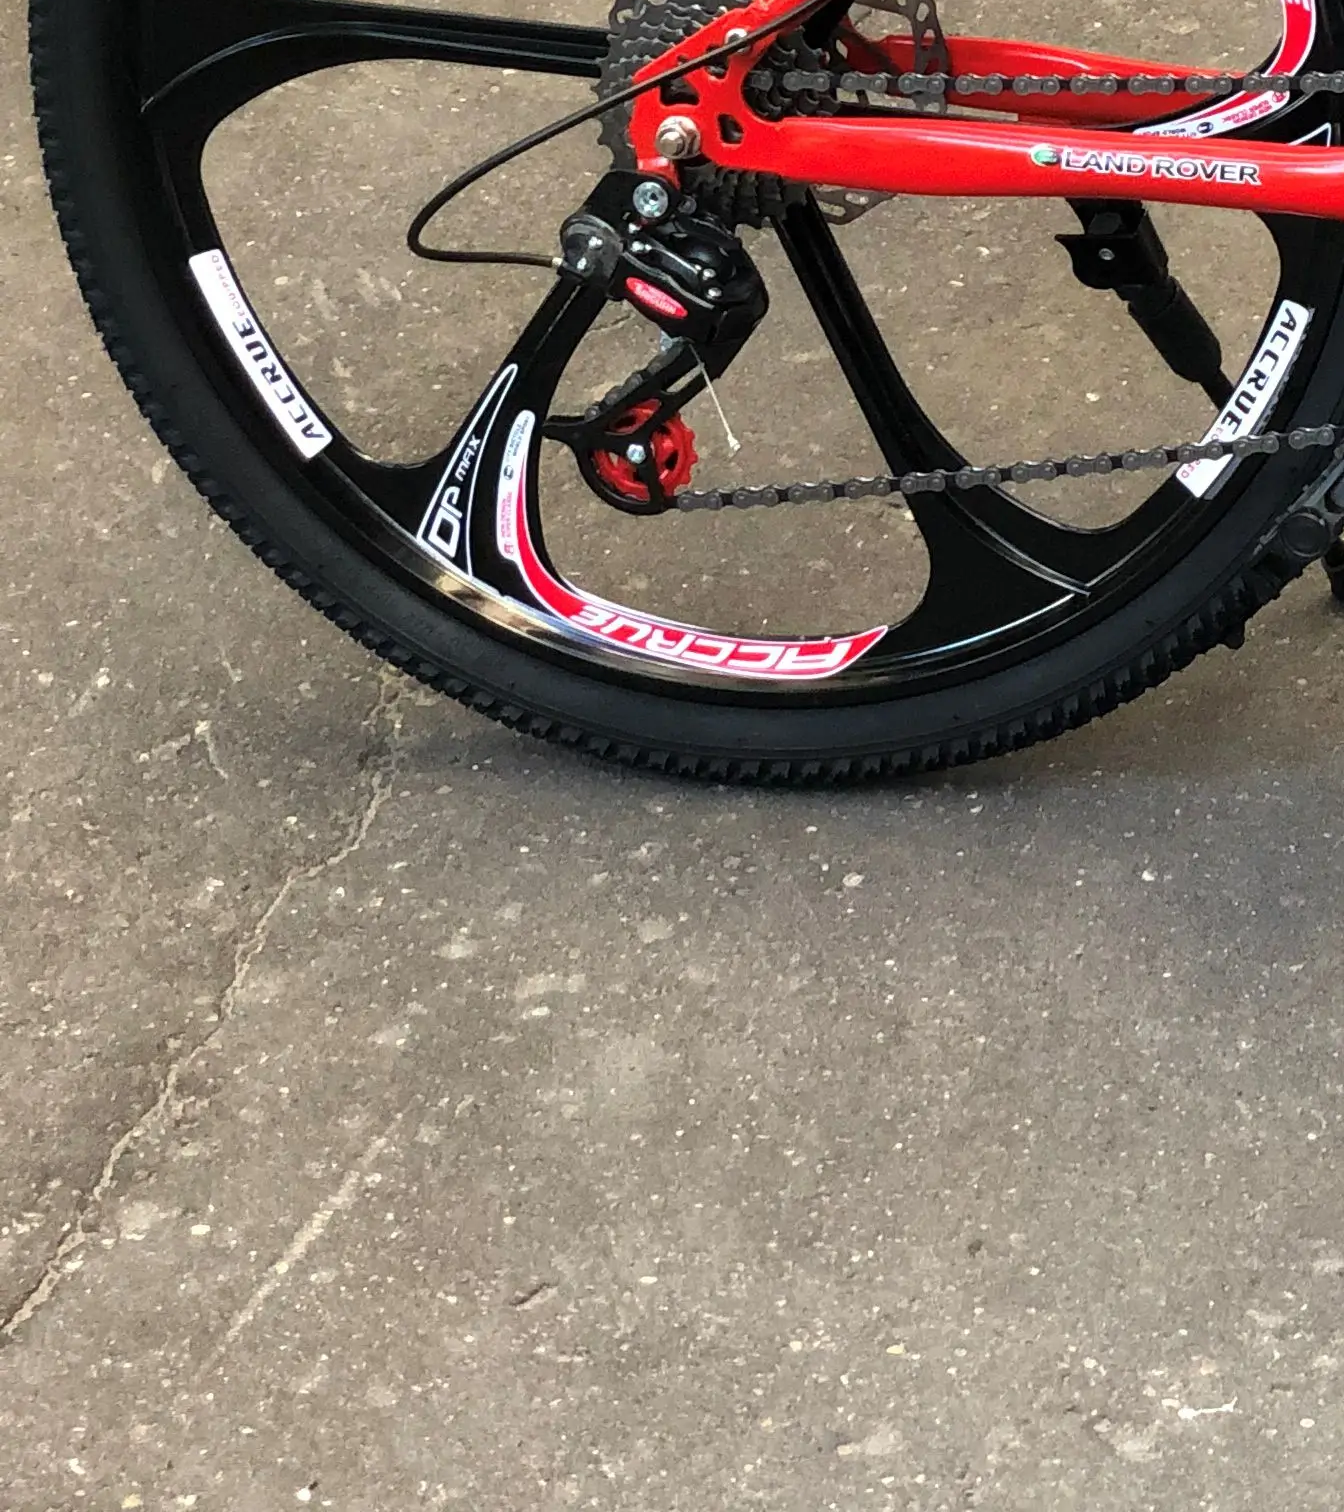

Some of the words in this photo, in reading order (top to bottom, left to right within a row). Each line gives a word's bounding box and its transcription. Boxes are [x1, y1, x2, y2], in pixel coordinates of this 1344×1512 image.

[1062, 146, 1148, 176] LAND
[1150, 157, 1262, 186] ROVER
[232, 317, 325, 439] ACCRUE
[1220, 307, 1298, 435] ACCRUE
[569, 603, 854, 670] ACCRUE
